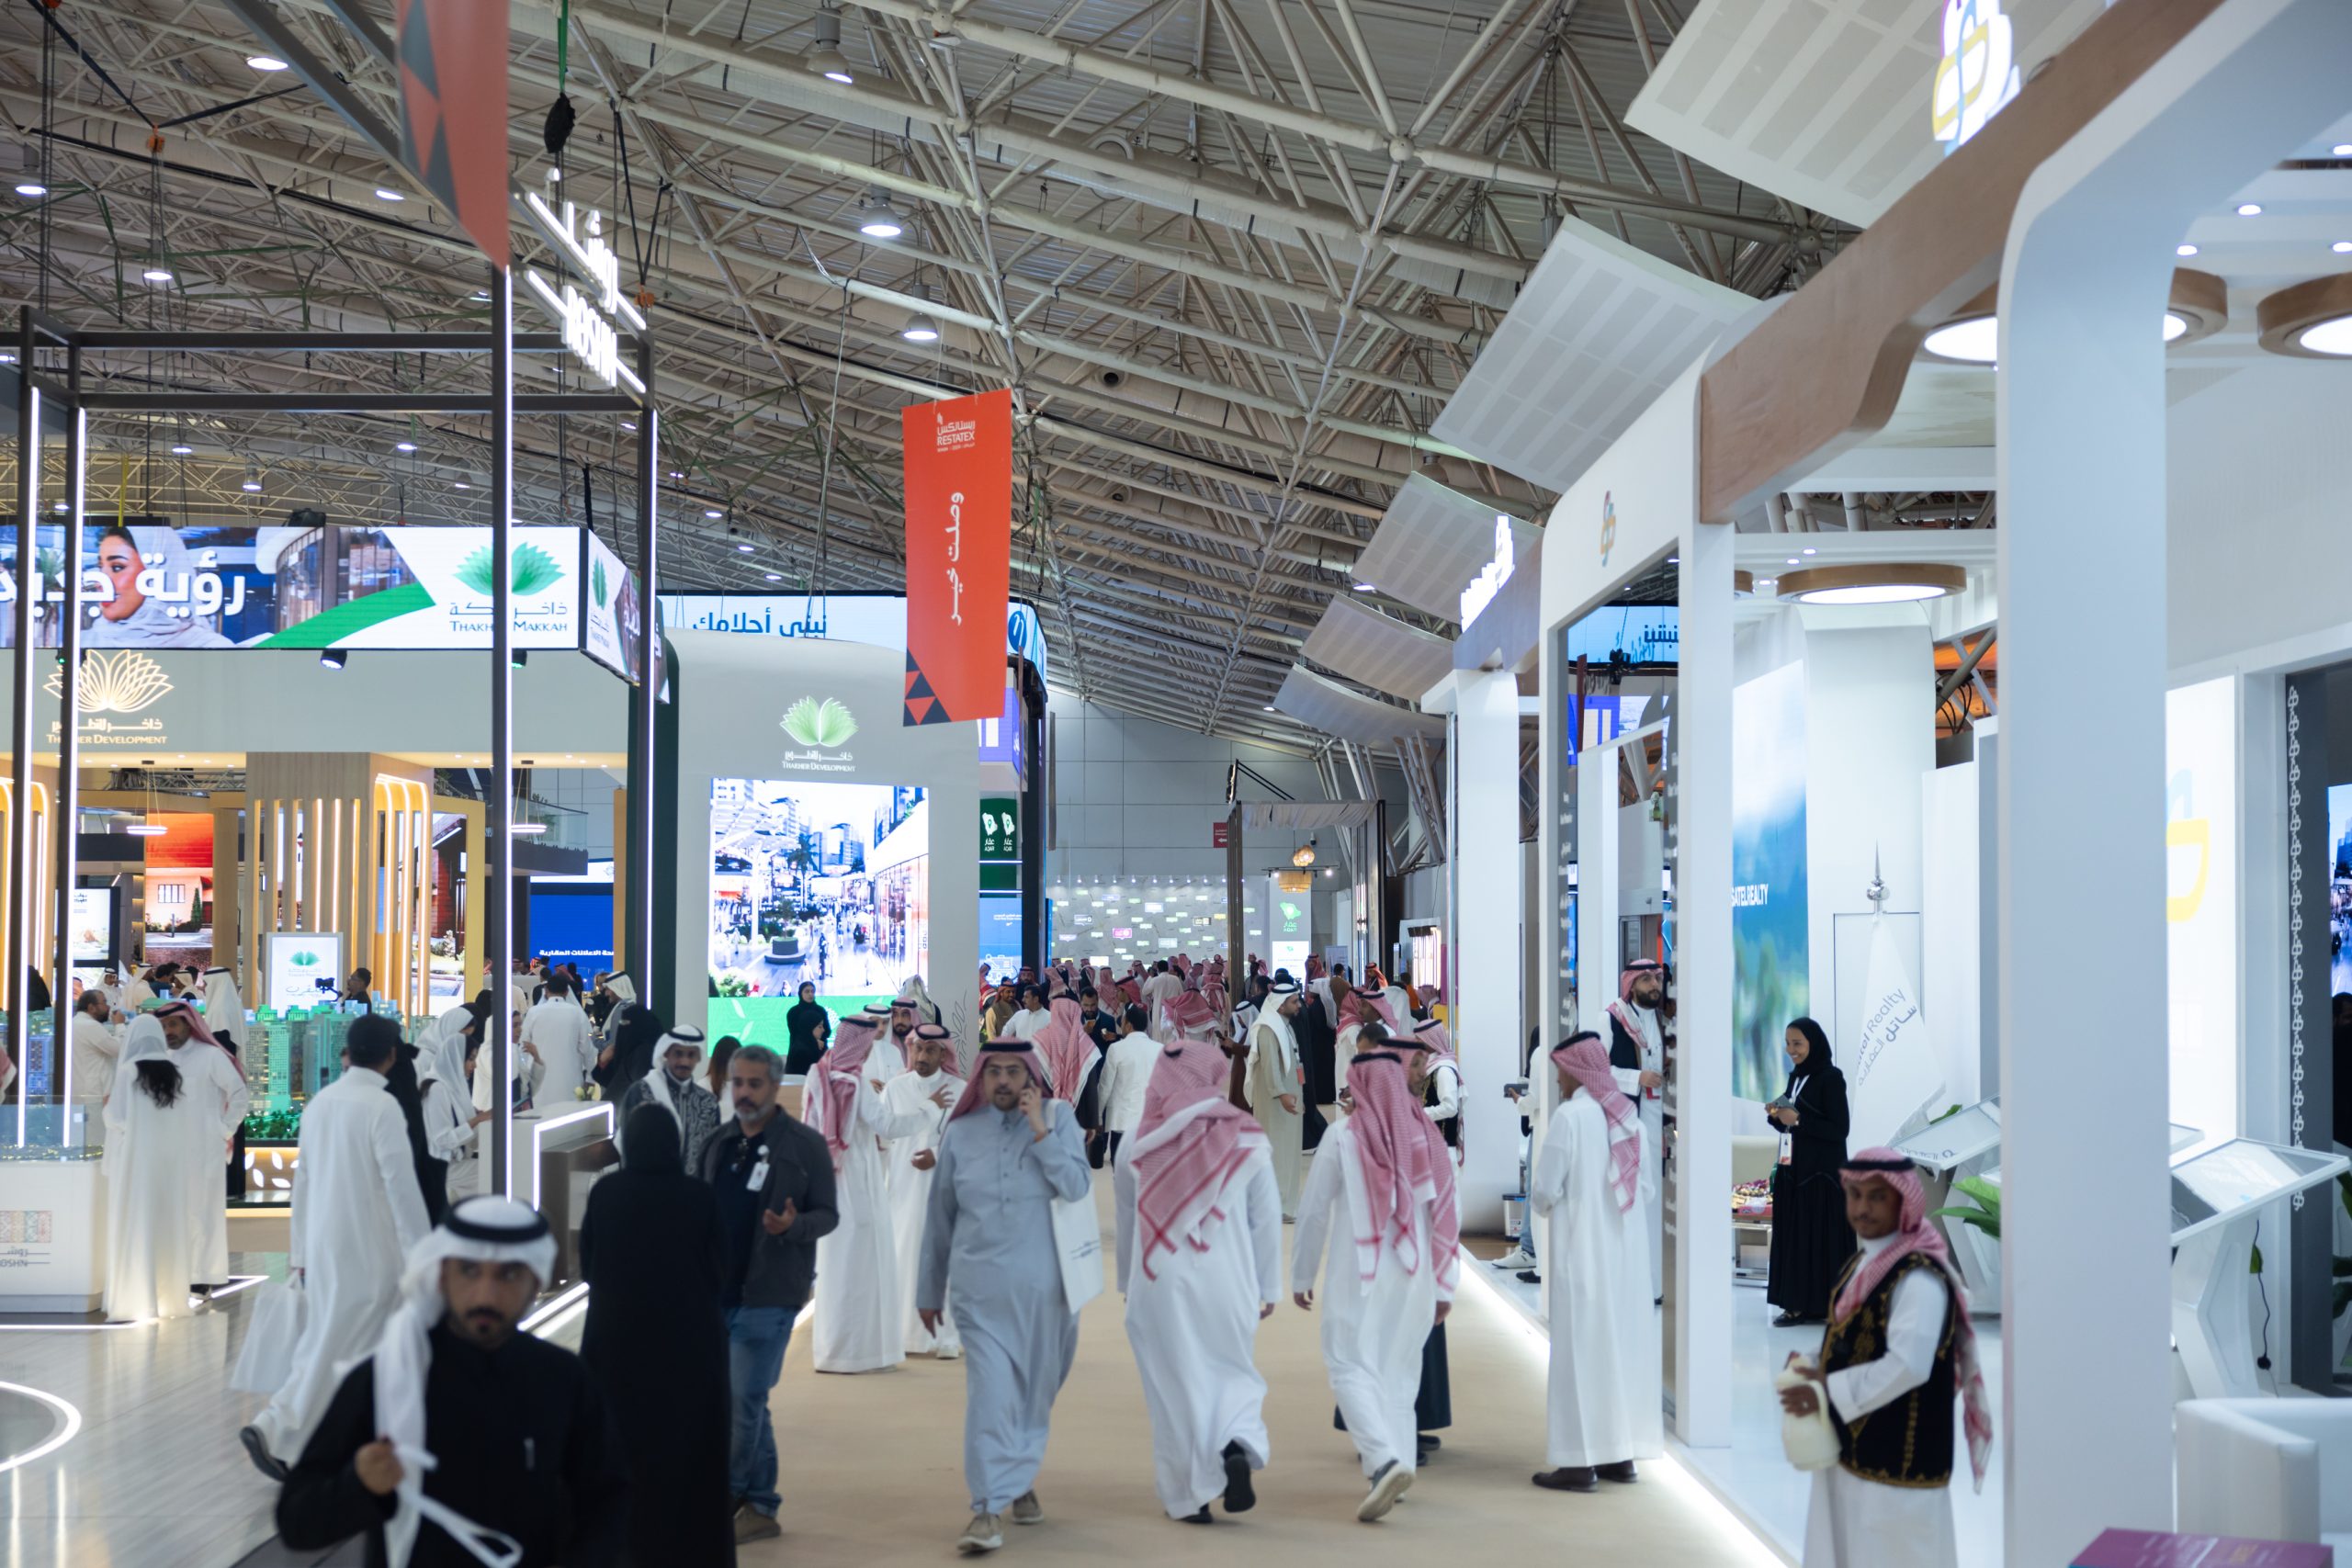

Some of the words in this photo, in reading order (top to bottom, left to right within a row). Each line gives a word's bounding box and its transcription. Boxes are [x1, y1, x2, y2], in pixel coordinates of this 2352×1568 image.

[562, 285, 618, 388] ROSHN
[936, 430, 976, 446] RESTATEX
[944, 491, 964, 562] وصلت
[135, 549, 246, 618] رؤية
[945, 568, 963, 626] خير
[448, 620, 494, 632] THAKH
[513, 620, 568, 632] MAKKAH
[692, 606, 772, 634] أحلامك
[93, 734, 167, 745] DEVELOPMENT
[809, 761, 856, 773] DEVELOPMENT
[1866, 987, 1906, 1034] Realty
[1885, 1005, 1917, 1043] ساتل
[0, 1258, 28, 1268] OSHN
